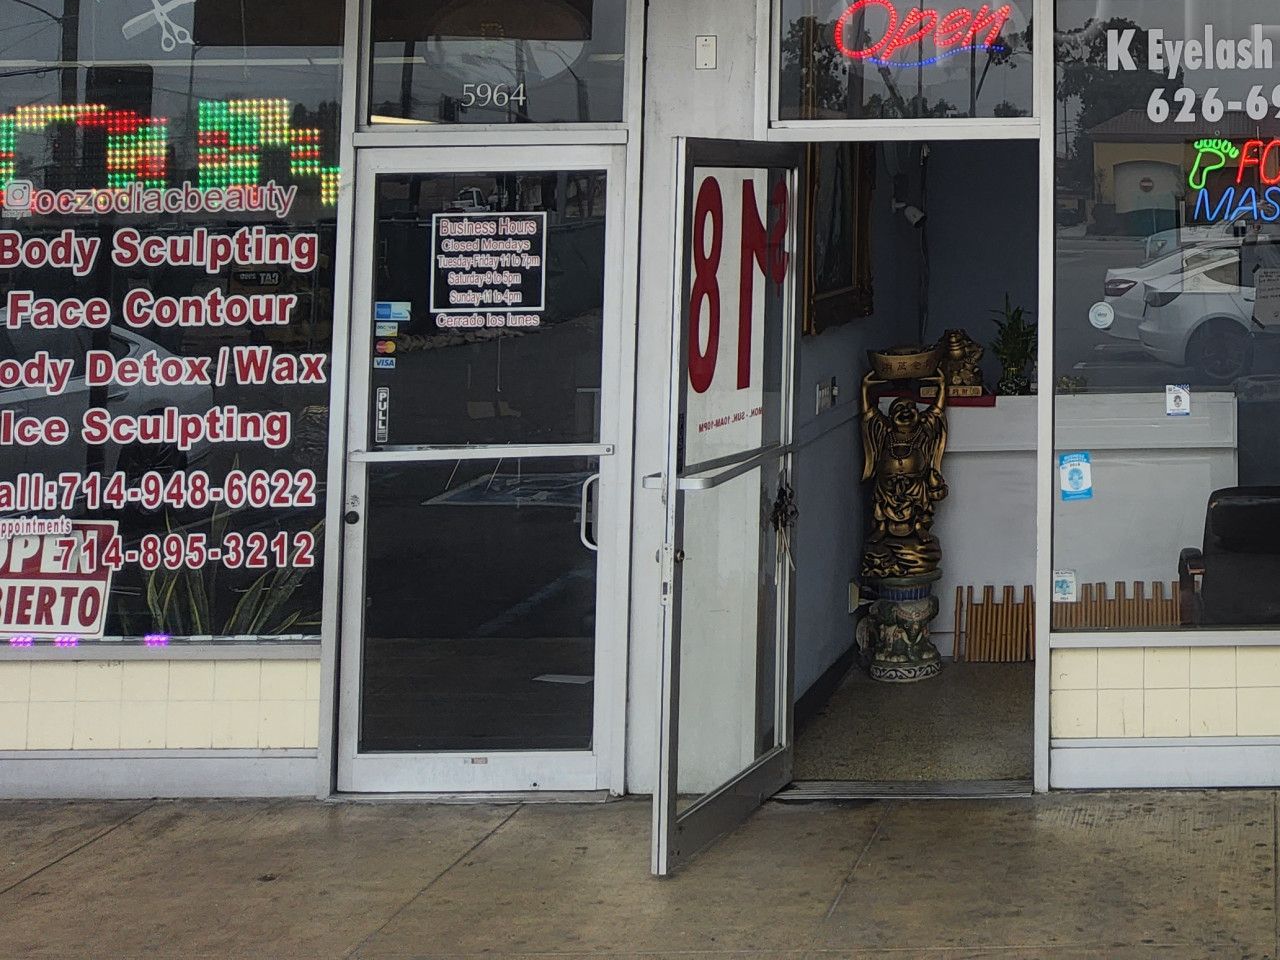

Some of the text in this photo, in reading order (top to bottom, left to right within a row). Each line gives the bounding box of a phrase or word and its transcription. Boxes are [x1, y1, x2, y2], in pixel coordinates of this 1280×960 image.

[1107, 29, 1137, 71] K
[1148, 24, 1273, 79] Eyelash
[461, 83, 527, 107] 5964
[36, 181, 297, 217] oczodiacbeauty
[440, 217, 537, 236] Business Hours
[441, 238, 531, 253] Closed Mondays
[0, 227, 318, 276] Body Sculpting
[7, 287, 297, 330] Face Contour
[436, 312, 540, 327] Cerrado los lunes
[0, 406, 291, 450] Ice Sculpting
[378, 392, 387, 429] PULL
[58, 531, 315, 570] 714-895-3212
[0, 585, 101, 627] IERTO
